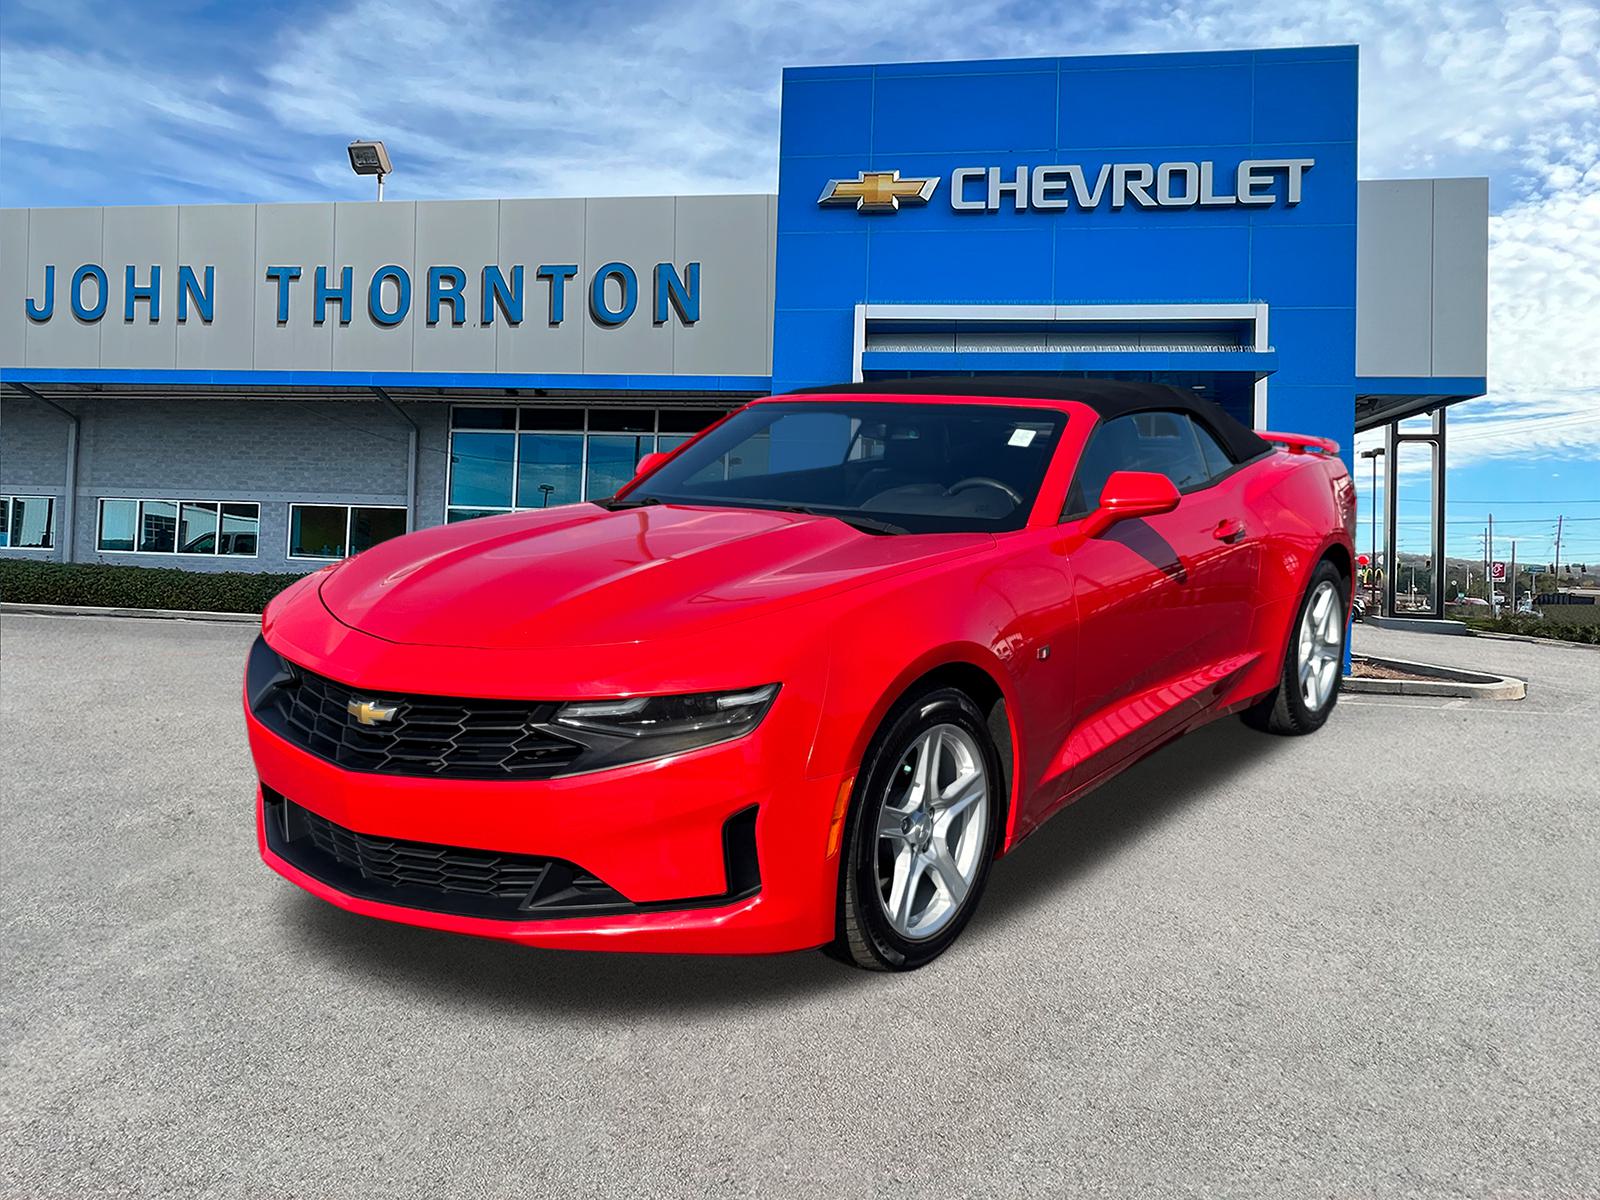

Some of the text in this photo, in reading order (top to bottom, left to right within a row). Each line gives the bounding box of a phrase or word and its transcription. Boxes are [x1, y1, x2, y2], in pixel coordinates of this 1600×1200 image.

[951, 158, 1316, 210] CHEVROLET
[26, 262, 702, 327] JOHN THORNTON
